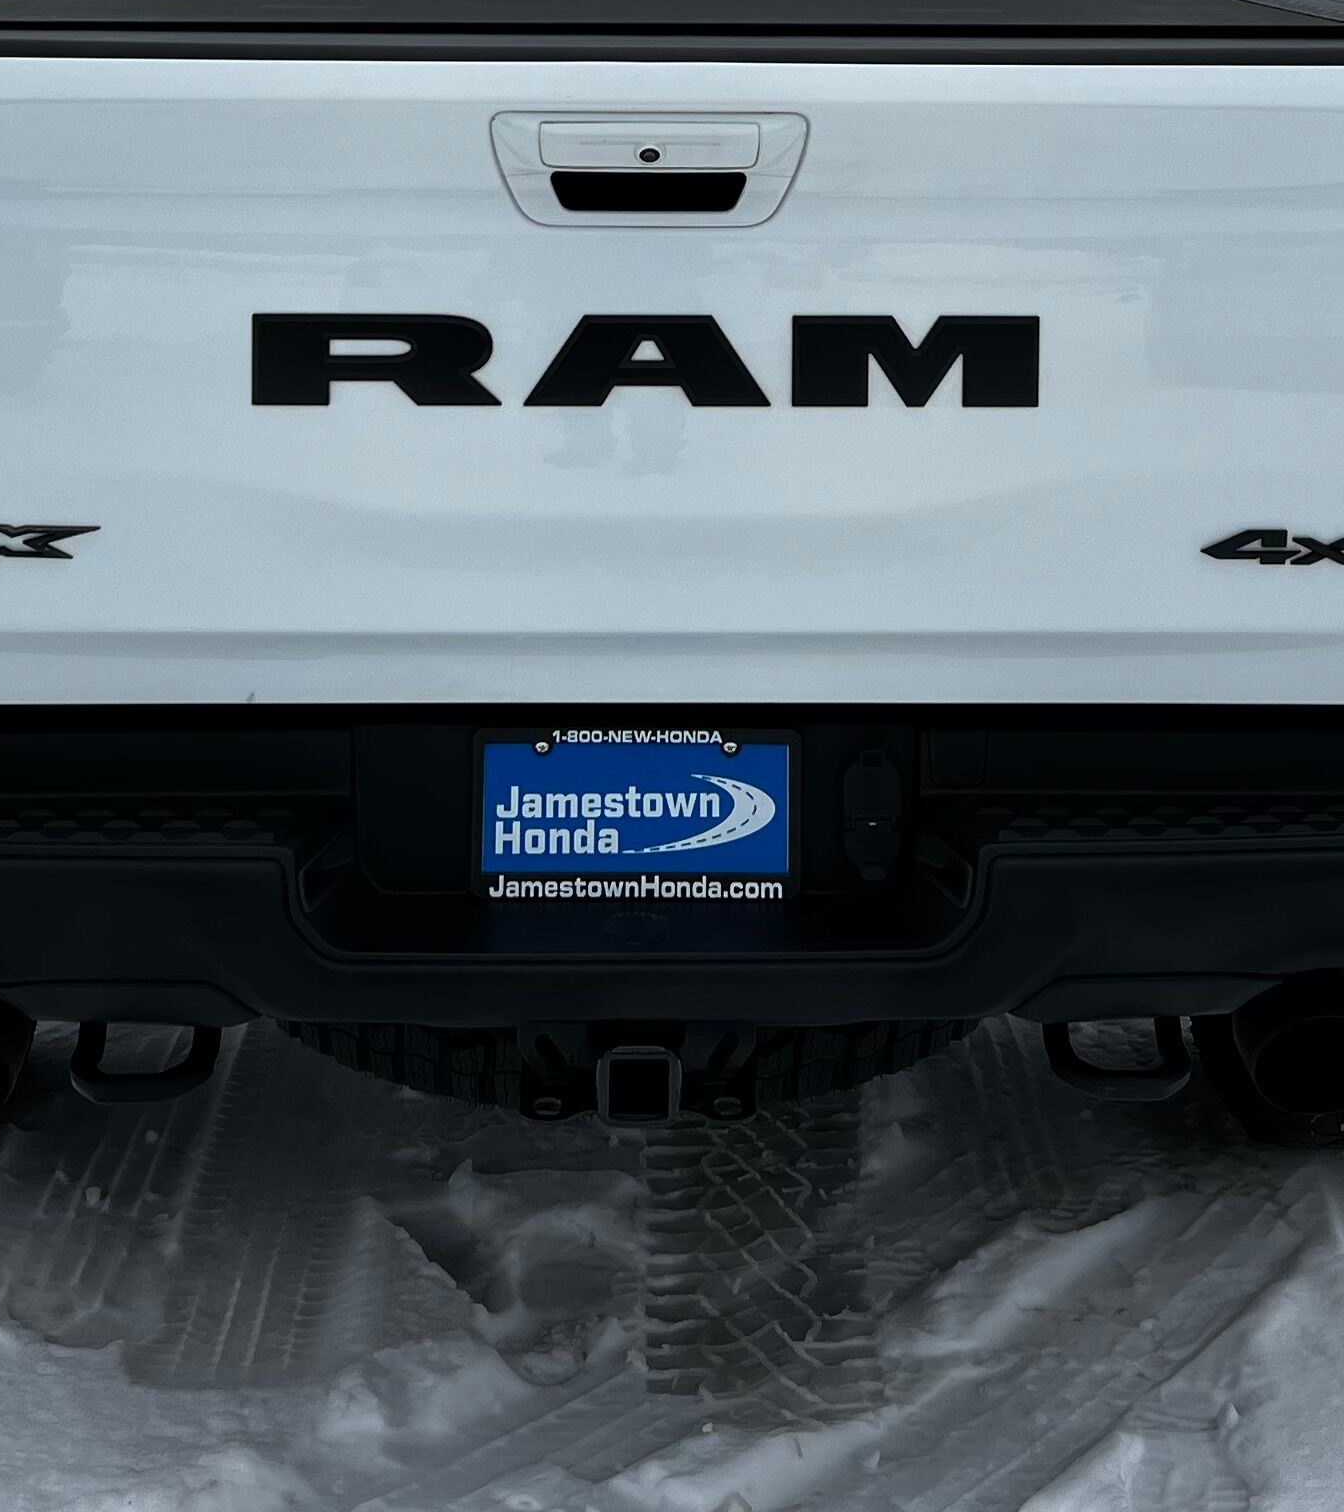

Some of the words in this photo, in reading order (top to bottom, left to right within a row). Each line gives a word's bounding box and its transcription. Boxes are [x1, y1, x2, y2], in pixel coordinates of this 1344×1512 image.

[252, 313, 1040, 407] RAM
[552, 730, 723, 745] 1-800-NEW-HONDA
[496, 785, 720, 819] Jamestown
[495, 819, 619, 855] Honda
[489, 875, 784, 900] JamestownHonda.com
